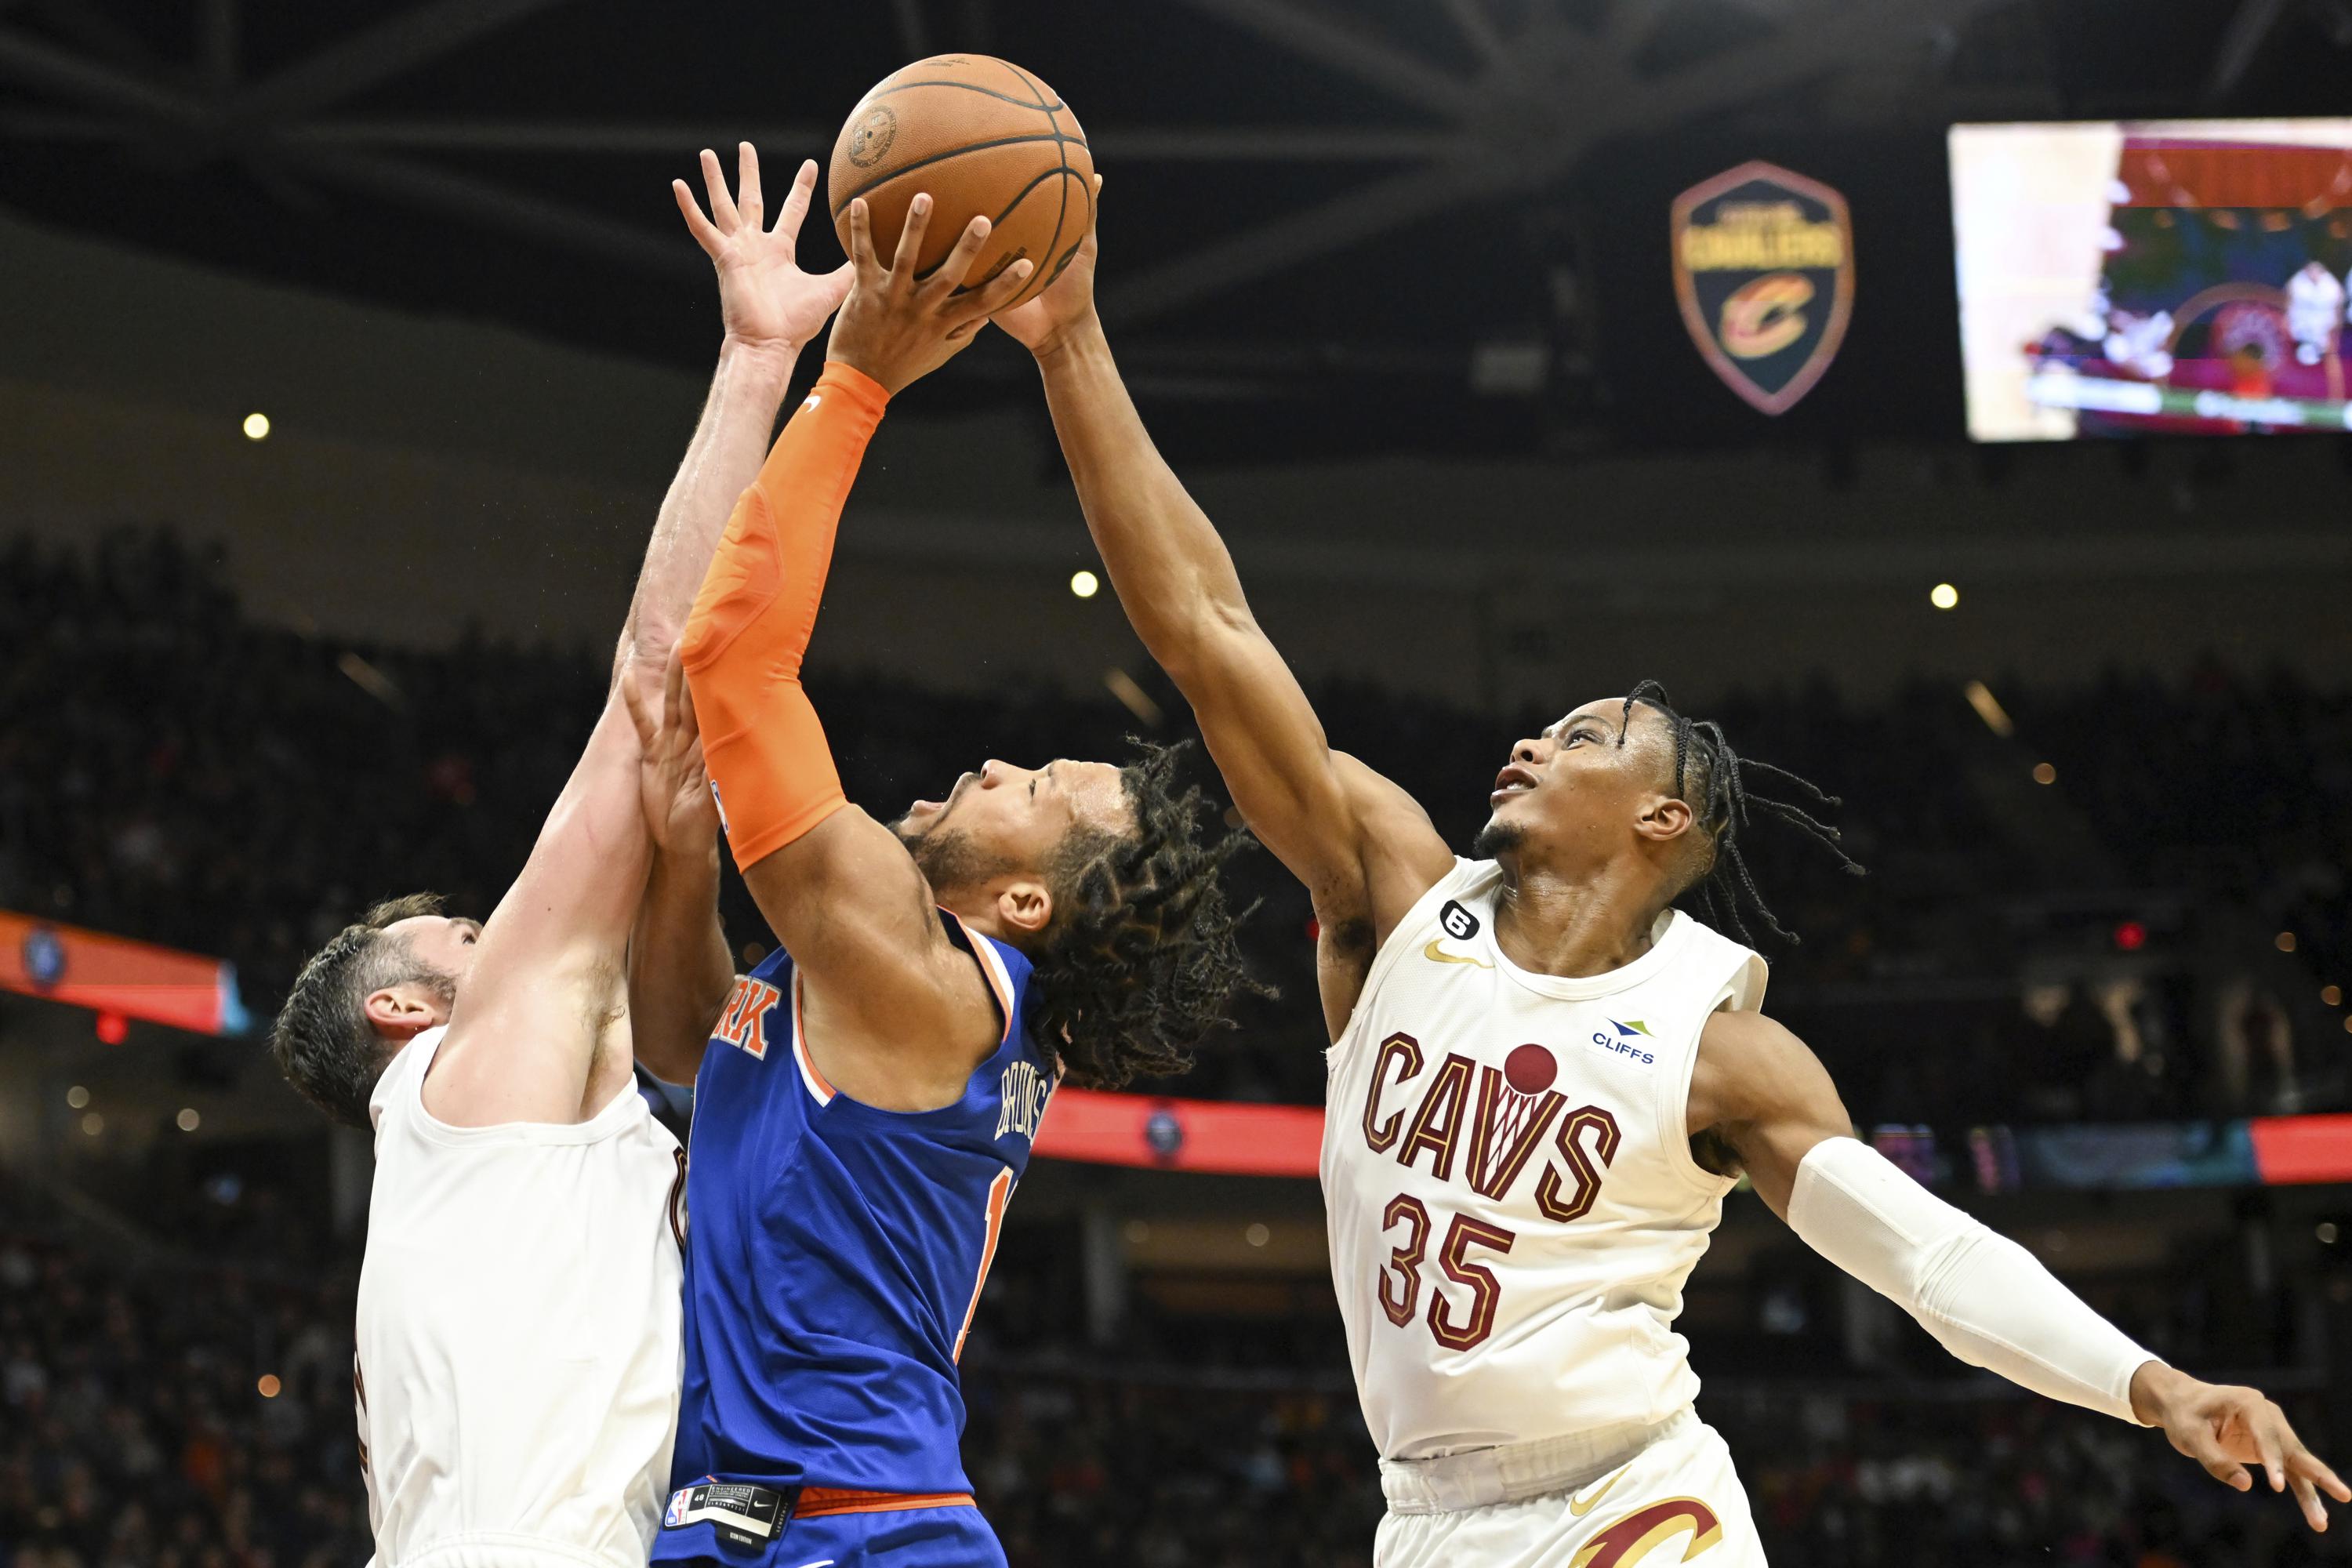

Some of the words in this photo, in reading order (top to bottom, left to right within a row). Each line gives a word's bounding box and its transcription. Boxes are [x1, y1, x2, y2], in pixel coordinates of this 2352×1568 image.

[1446, 907, 1471, 937] 6
[1592, 1033, 1654, 1065] CLIFFS
[994, 1061, 1051, 1147] BRUNS
[1363, 1031, 1621, 1223] CAVS
[1378, 1192, 1516, 1352] 35
